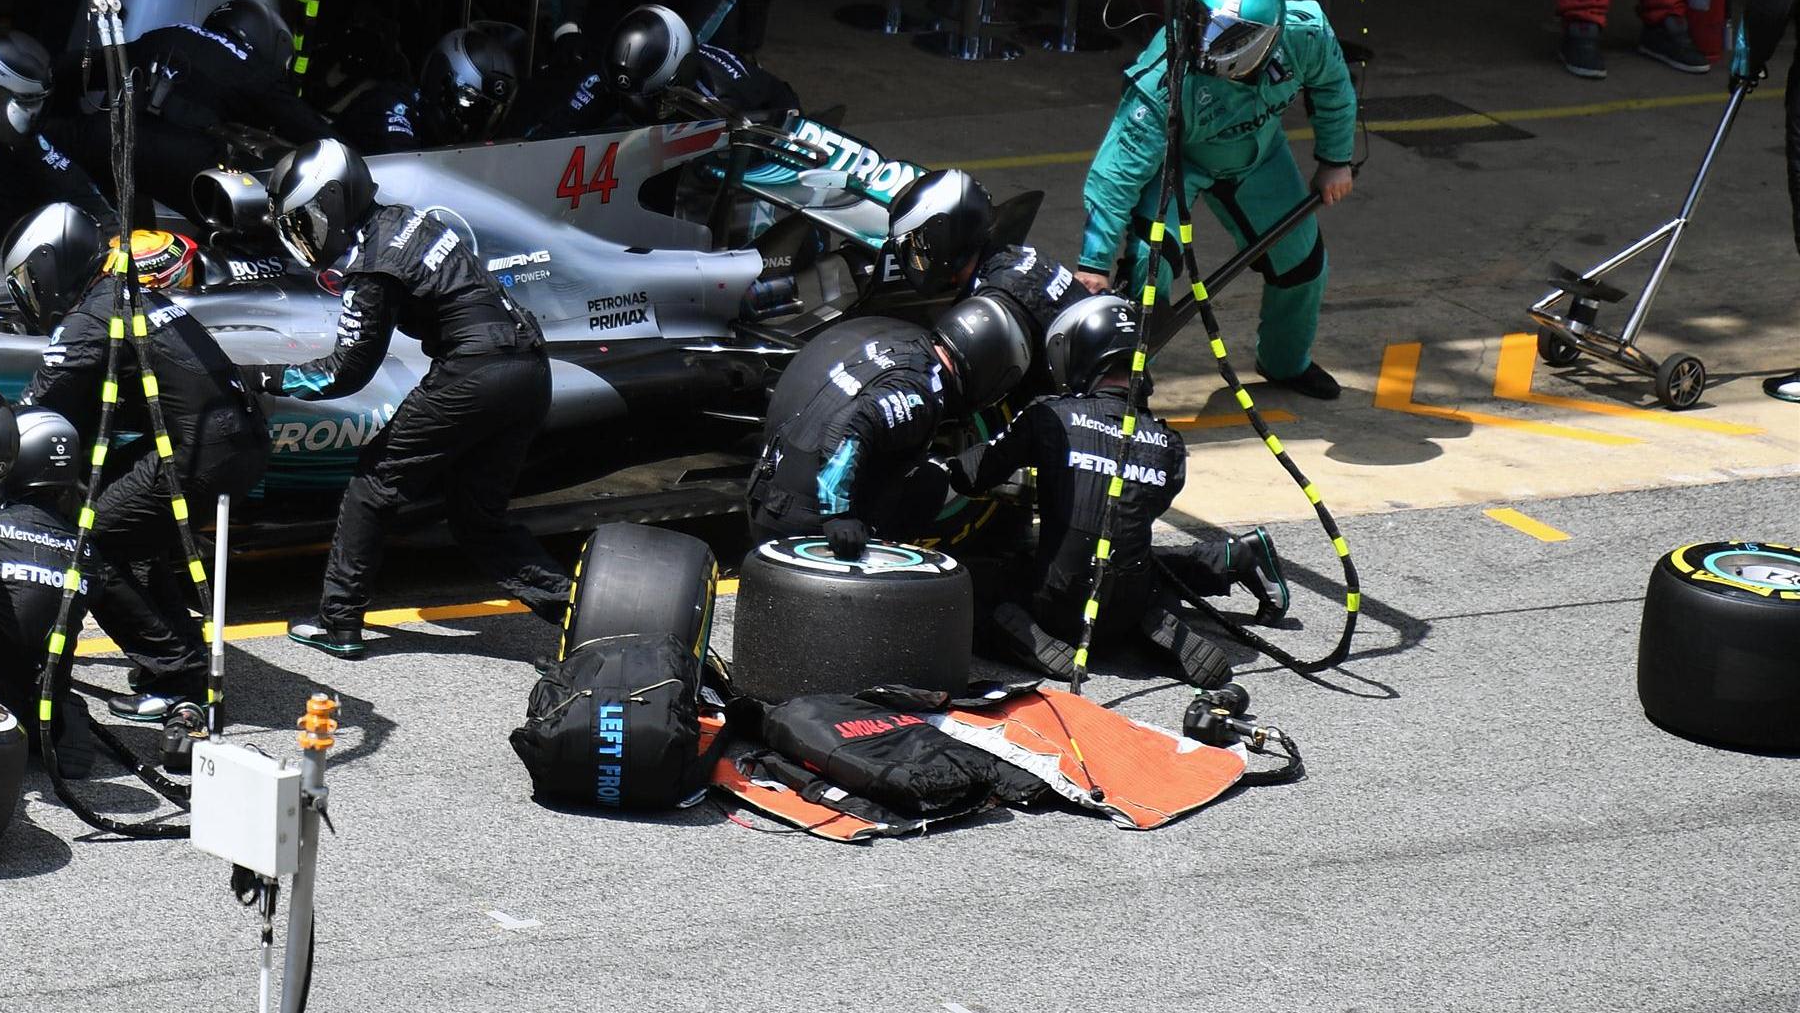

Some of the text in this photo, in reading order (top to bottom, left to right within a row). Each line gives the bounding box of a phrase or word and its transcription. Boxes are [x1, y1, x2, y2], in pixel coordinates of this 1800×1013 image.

[556, 141, 619, 210] 44
[229, 256, 283, 277] BOSS
[587, 291, 648, 313] PETRONAS
[589, 308, 649, 331] PRIMAX
[1071, 412, 1169, 448] Mercede-AMG
[0, 524, 91, 557] Mercedes-AG
[599, 705, 624, 758] LEFT
[199, 755, 216, 777] 79
